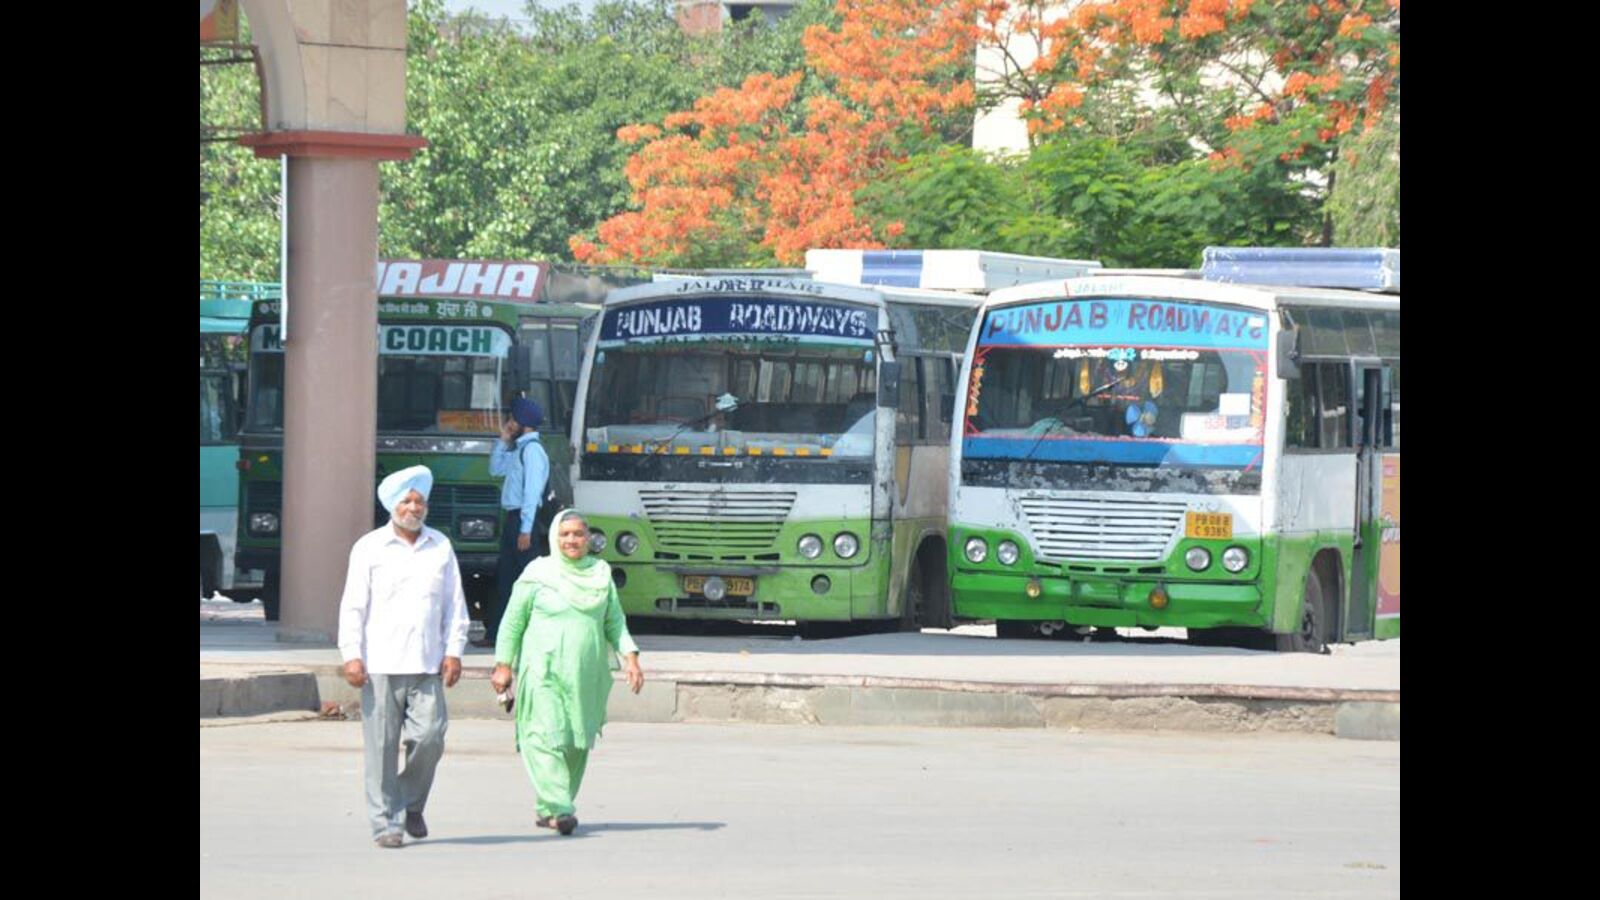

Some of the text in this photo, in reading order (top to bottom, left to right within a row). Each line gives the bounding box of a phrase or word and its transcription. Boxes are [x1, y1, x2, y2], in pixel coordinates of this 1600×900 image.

[616, 302, 867, 337] PUNJAB ROADWAYS
[989, 302, 1108, 338] PUNJAB
[386, 327, 492, 353] COACH
